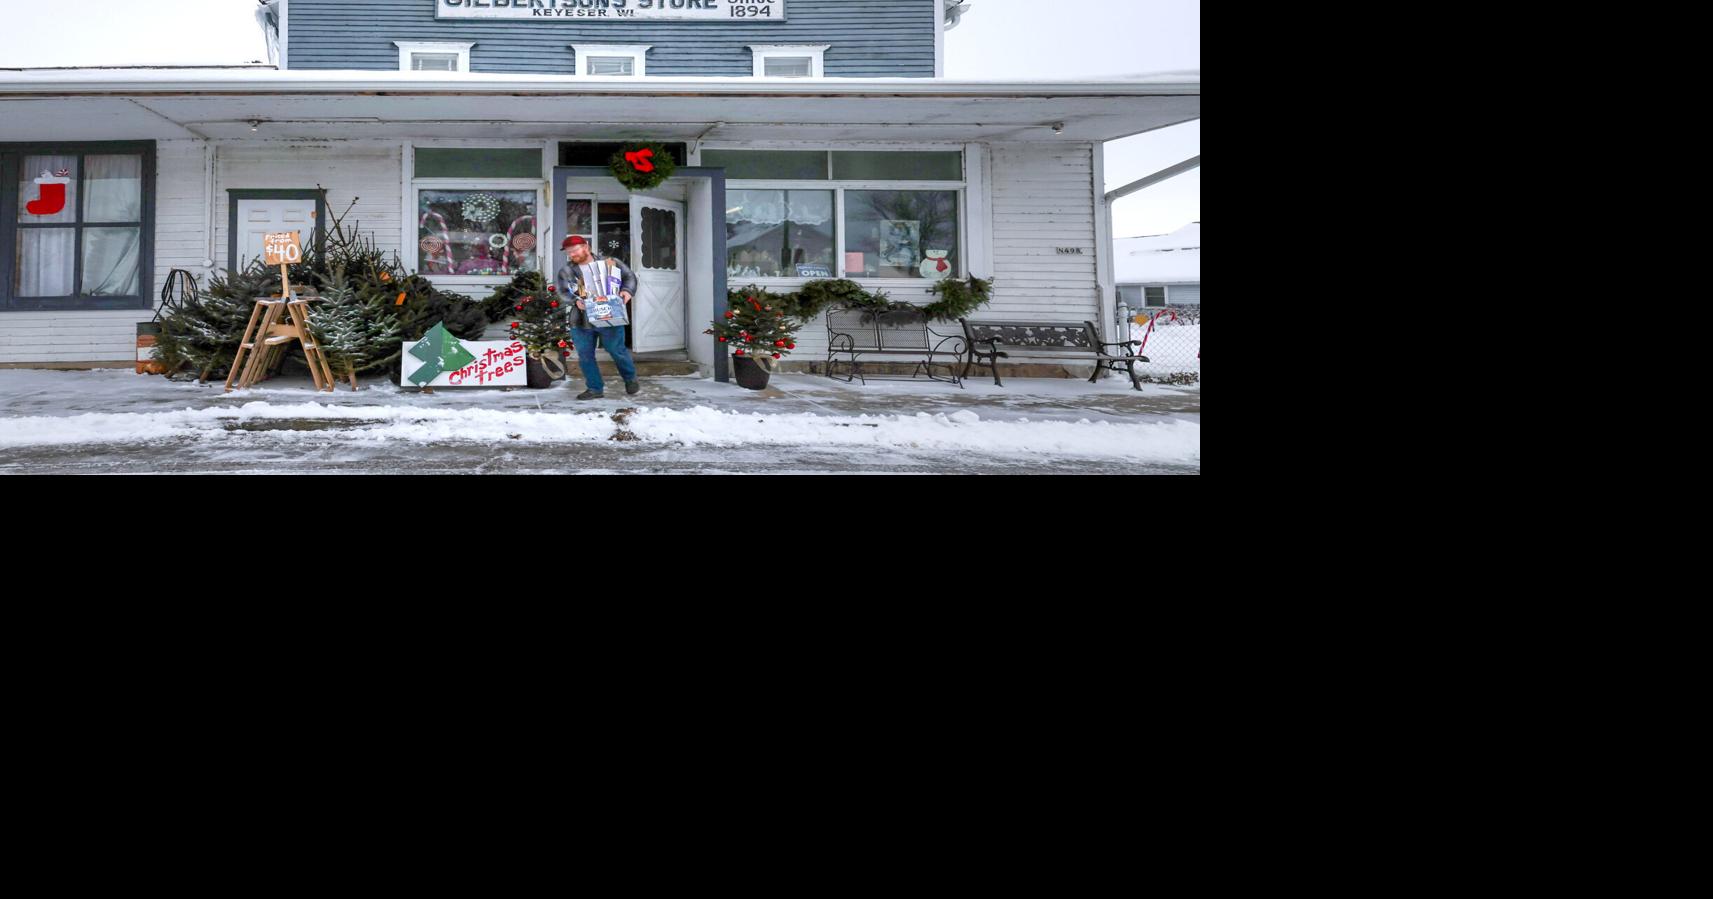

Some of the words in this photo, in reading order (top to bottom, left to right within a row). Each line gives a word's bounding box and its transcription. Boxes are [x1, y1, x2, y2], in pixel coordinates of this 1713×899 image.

[730, 5, 771, 17] 1894
[265, 243, 299, 262] $40
[448, 341, 525, 385] Christmas
